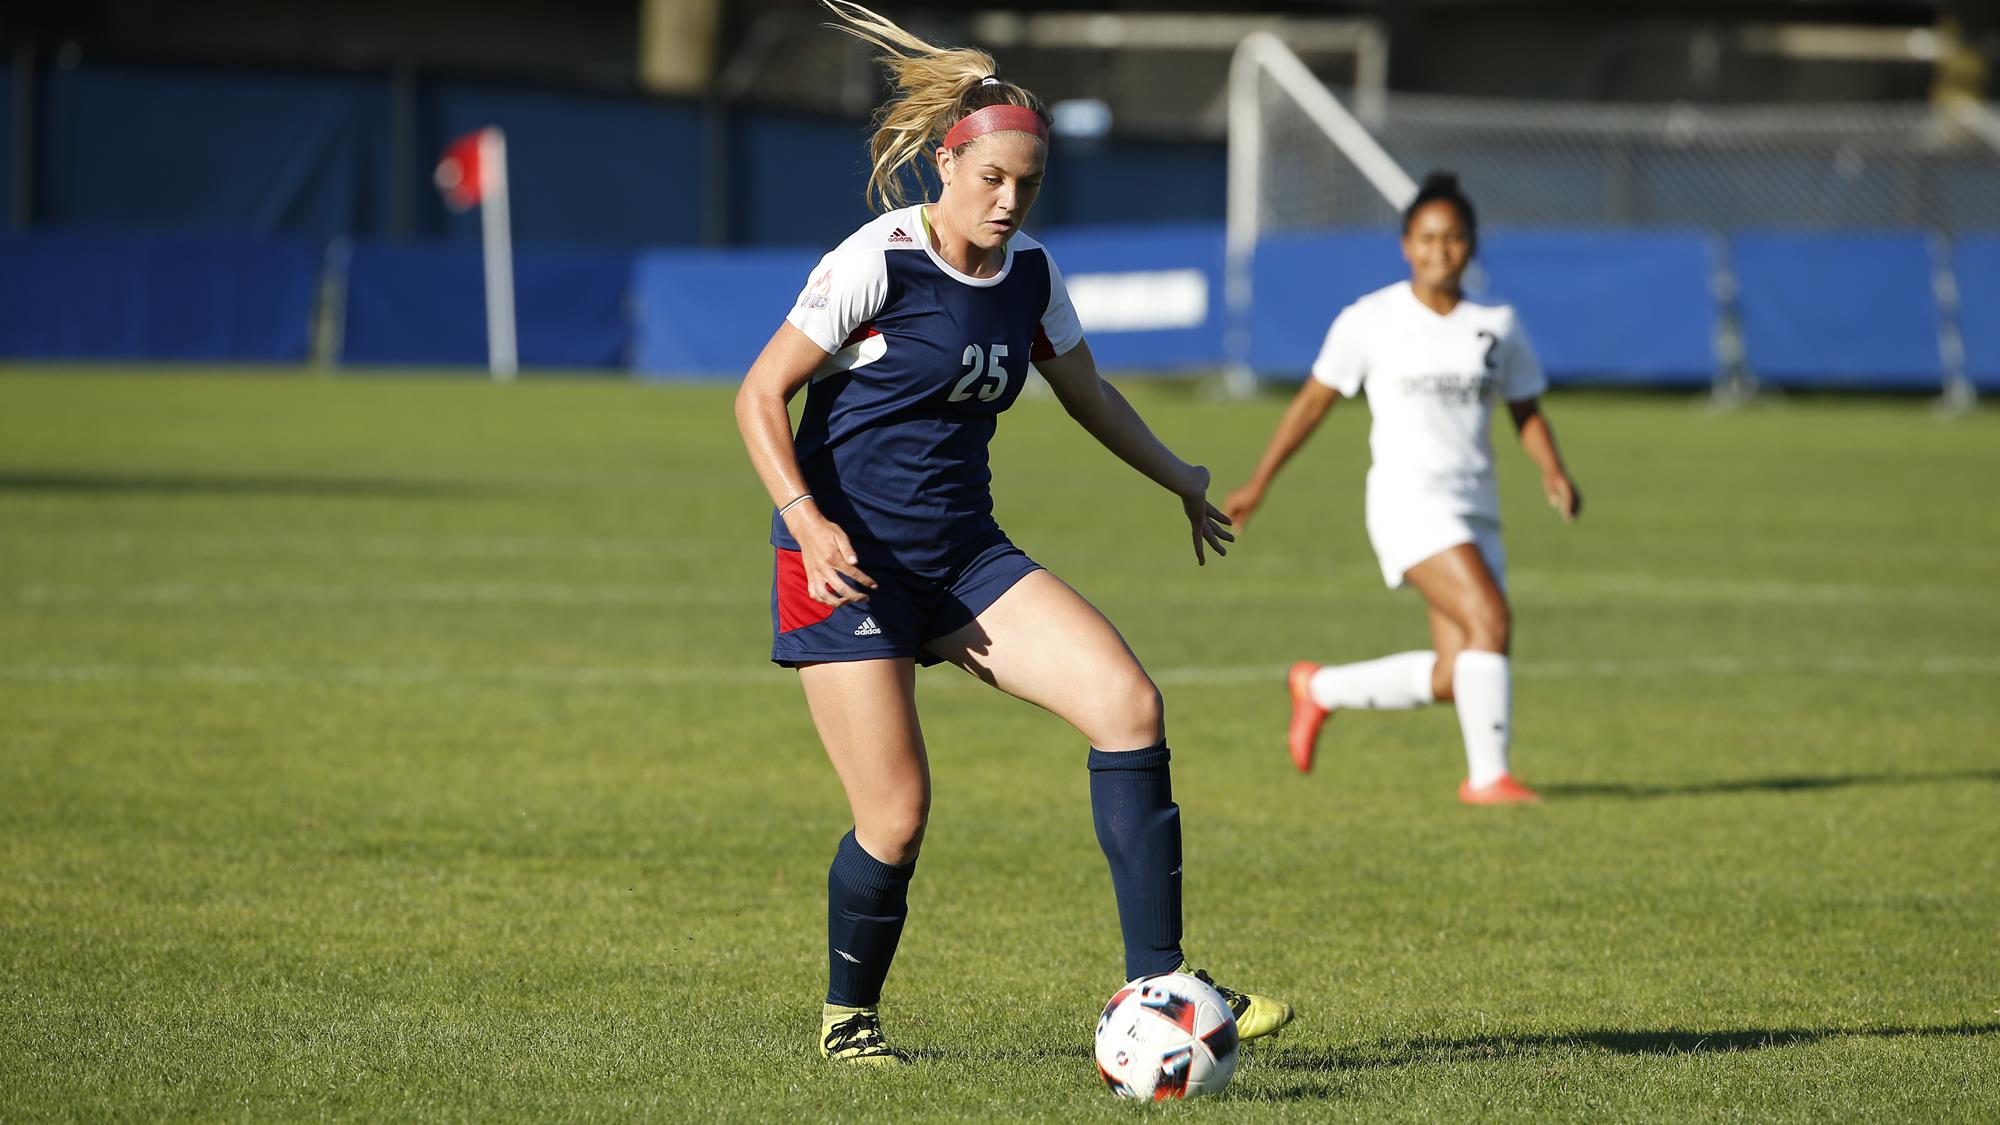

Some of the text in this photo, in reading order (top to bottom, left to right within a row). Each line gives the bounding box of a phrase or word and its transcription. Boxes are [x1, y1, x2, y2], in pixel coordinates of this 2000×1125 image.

[1476, 330, 1498, 369] 2
[947, 343, 1009, 402] 25
[854, 627, 882, 636] adidas
